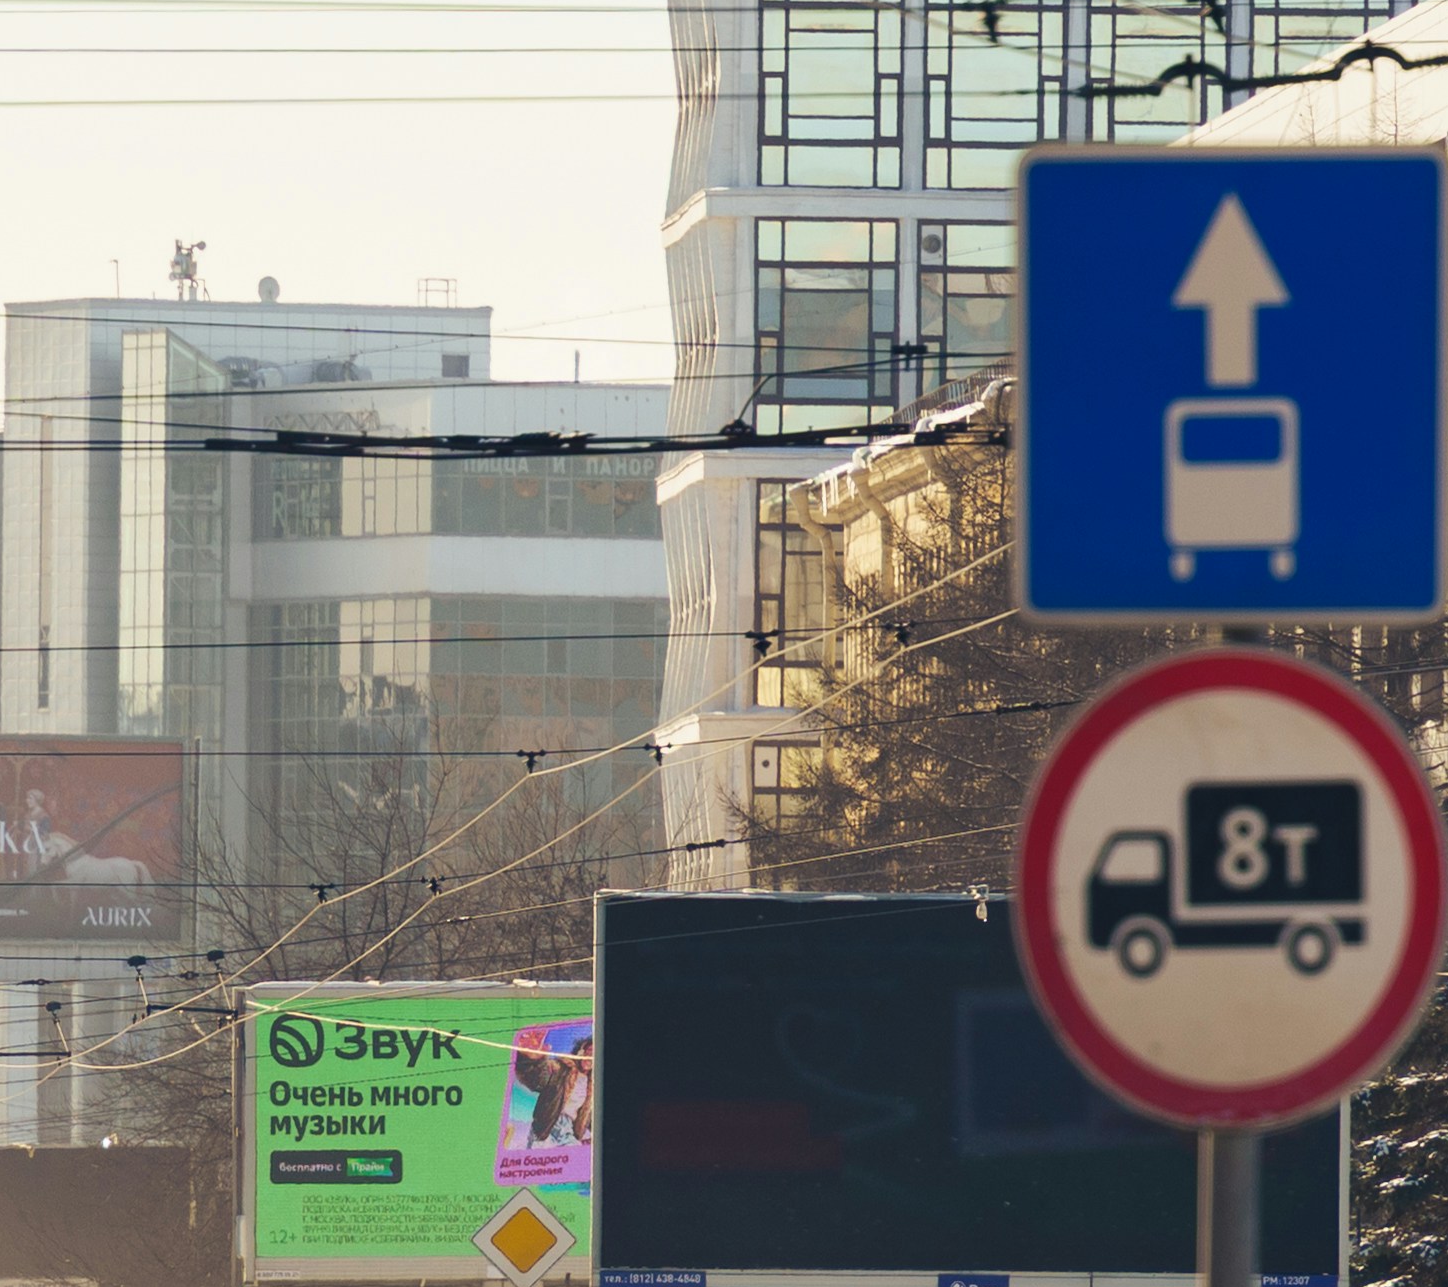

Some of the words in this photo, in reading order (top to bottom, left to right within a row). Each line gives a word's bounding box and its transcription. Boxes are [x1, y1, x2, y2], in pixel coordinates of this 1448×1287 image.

[82, 906, 152, 927] AURIX
[335, 1019, 462, 1067] Звук
[270, 1081, 363, 1106] Очень
[371, 1085, 463, 1106] много
[270, 1115, 386, 1142] музыки
[279, 1162, 334, 1172] бесплатно
